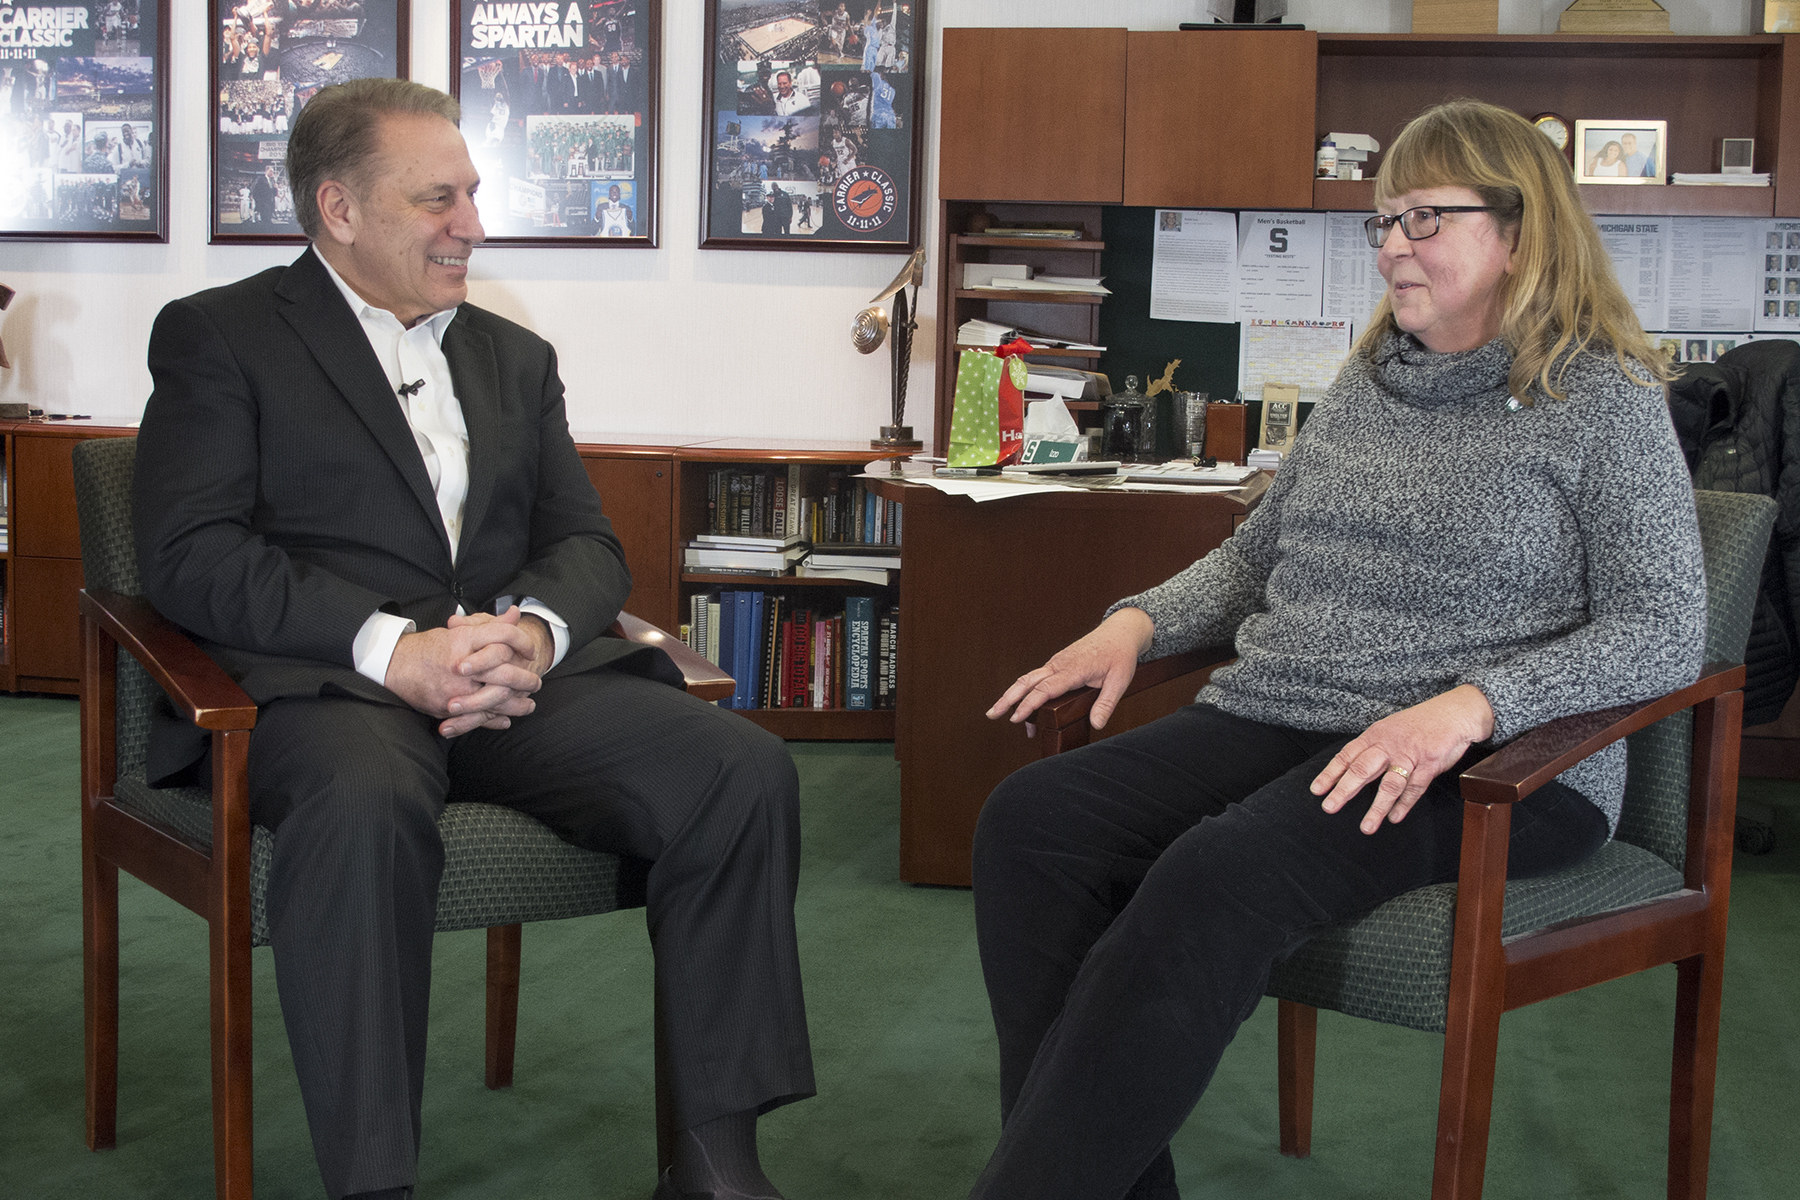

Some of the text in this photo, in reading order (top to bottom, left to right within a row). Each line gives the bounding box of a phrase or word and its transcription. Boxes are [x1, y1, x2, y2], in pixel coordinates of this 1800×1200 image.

[0, 7, 89, 29] CARRIER
[471, 2, 584, 25] ALWAYS A
[0, 29, 73, 47] CLASSIC
[471, 24, 584, 49] SPARTAN
[836, 171, 894, 213] CARRIER CLASSIC
[1269, 227, 1288, 253] S
[1636, 224, 1659, 233] STATE
[1002, 429, 1023, 442] Ha
[775, 481, 784, 508] LOOSE
[880, 629, 889, 657] FOURTH
[889, 622, 897, 650] MARCH
[851, 621, 860, 689] ENCYCLOPEDIA
[860, 621, 869, 689] SPARTAN SPORTS
[880, 660, 889, 675] AND
[879, 677, 888, 696] LONG
